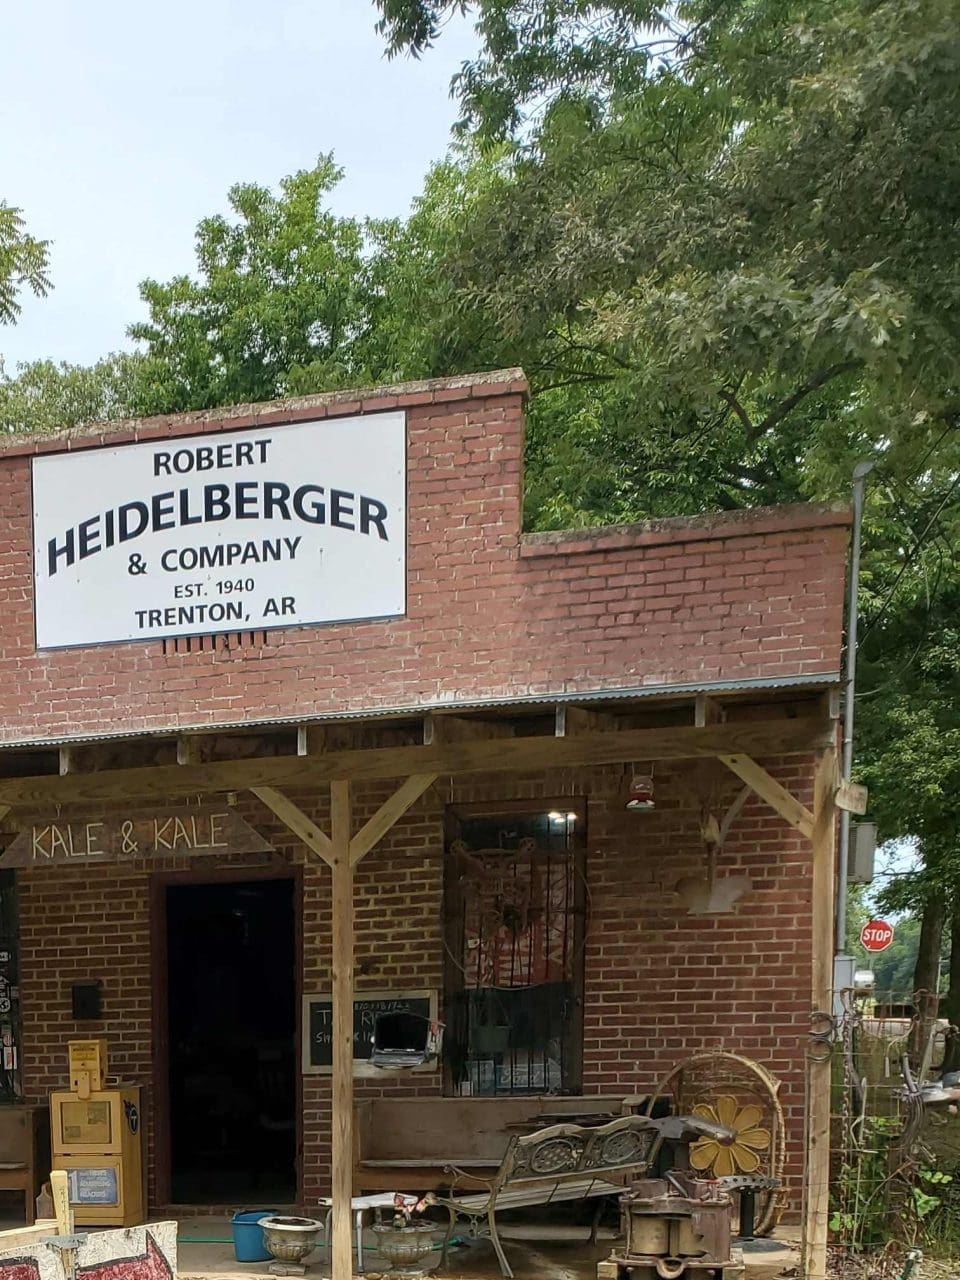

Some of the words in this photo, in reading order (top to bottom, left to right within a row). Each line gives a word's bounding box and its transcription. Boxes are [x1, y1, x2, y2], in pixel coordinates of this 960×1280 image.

[153, 439, 272, 476] ROBERT
[48, 481, 389, 577] HEIDELBERGER
[128, 552, 147, 576] &
[161, 536, 302, 573] COMPANY
[174, 582, 208, 600] EST.
[216, 578, 254, 595] 1940
[135, 602, 250, 630] TRENTON,
[262, 596, 296, 618] AR
[32, 823, 104, 860] KALE
[121, 820, 138, 854] &
[154, 813, 229, 850] KALE
[863, 928, 892, 942] STOP
